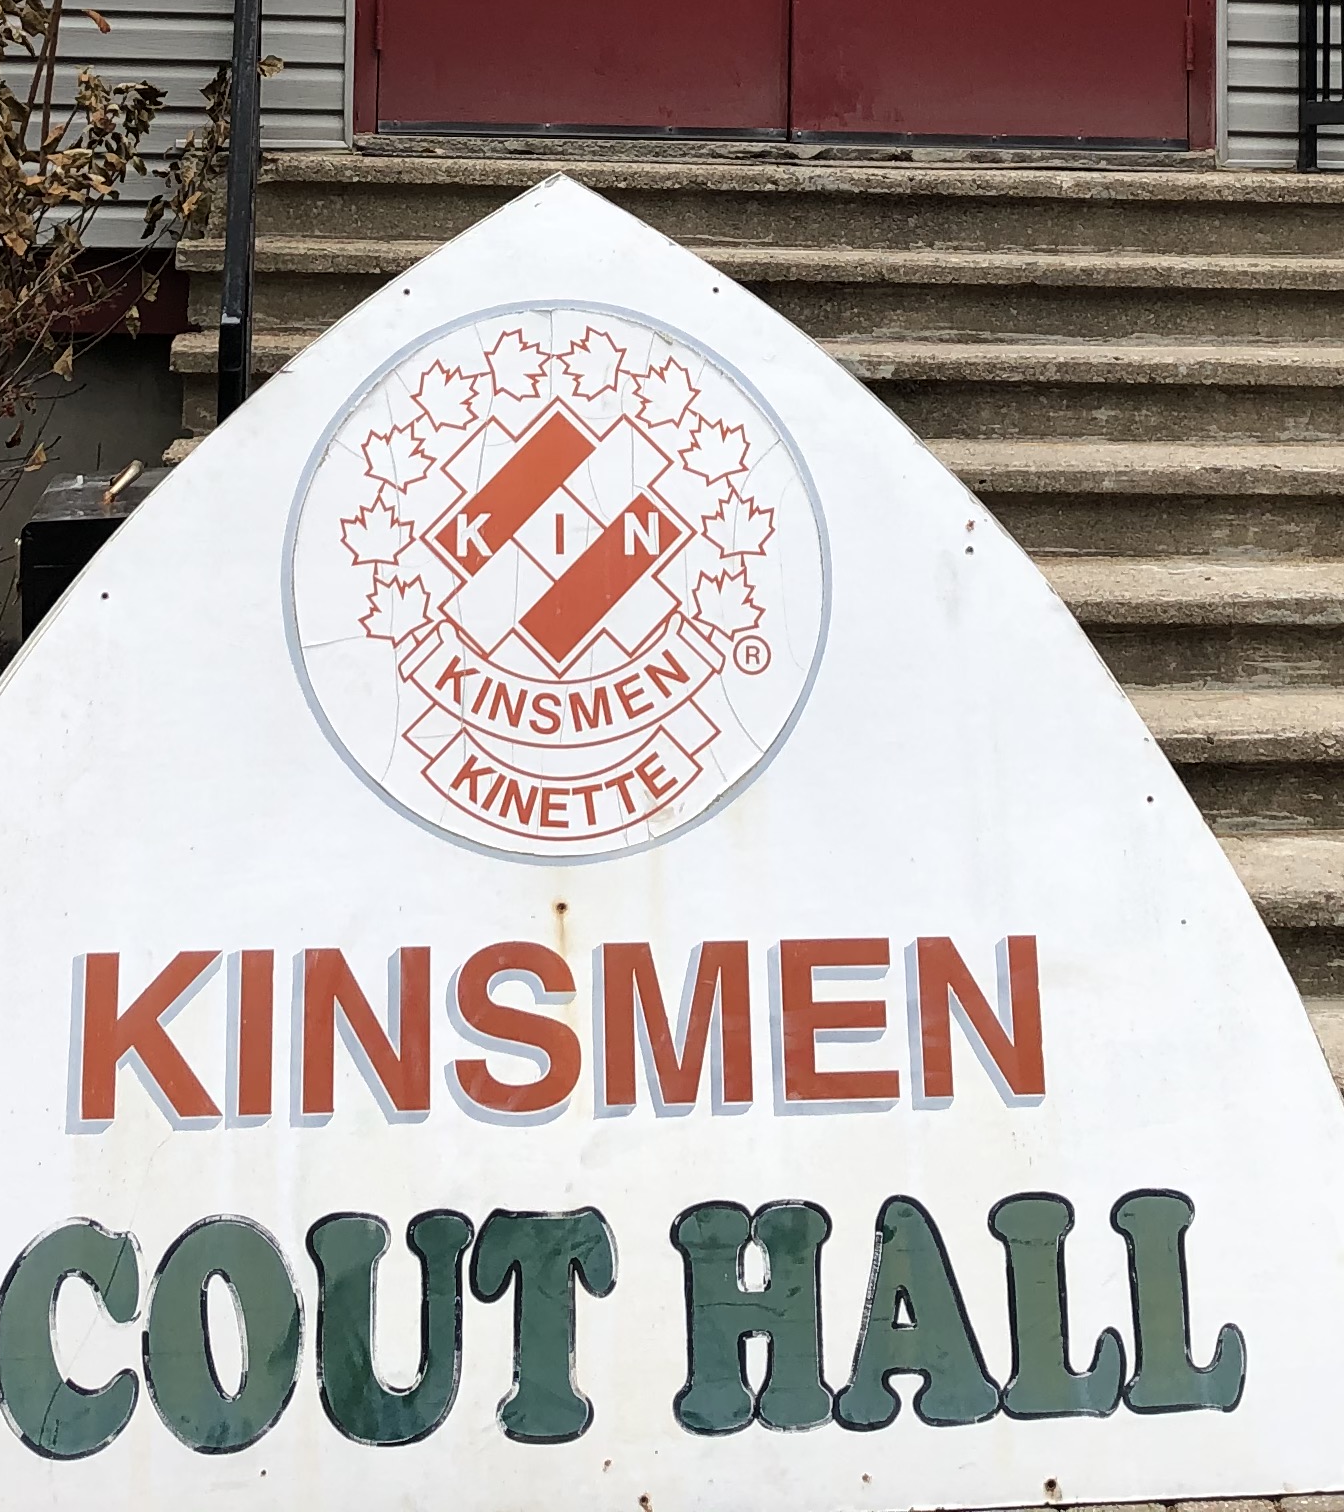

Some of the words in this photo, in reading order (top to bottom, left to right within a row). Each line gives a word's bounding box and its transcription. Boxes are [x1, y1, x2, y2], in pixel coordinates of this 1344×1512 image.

[434, 649, 691, 735] KINSMEN
[449, 750, 678, 829] KINETTE
[66, 934, 1046, 1132] KINSMEN
[670, 1188, 1247, 1437] HALL
